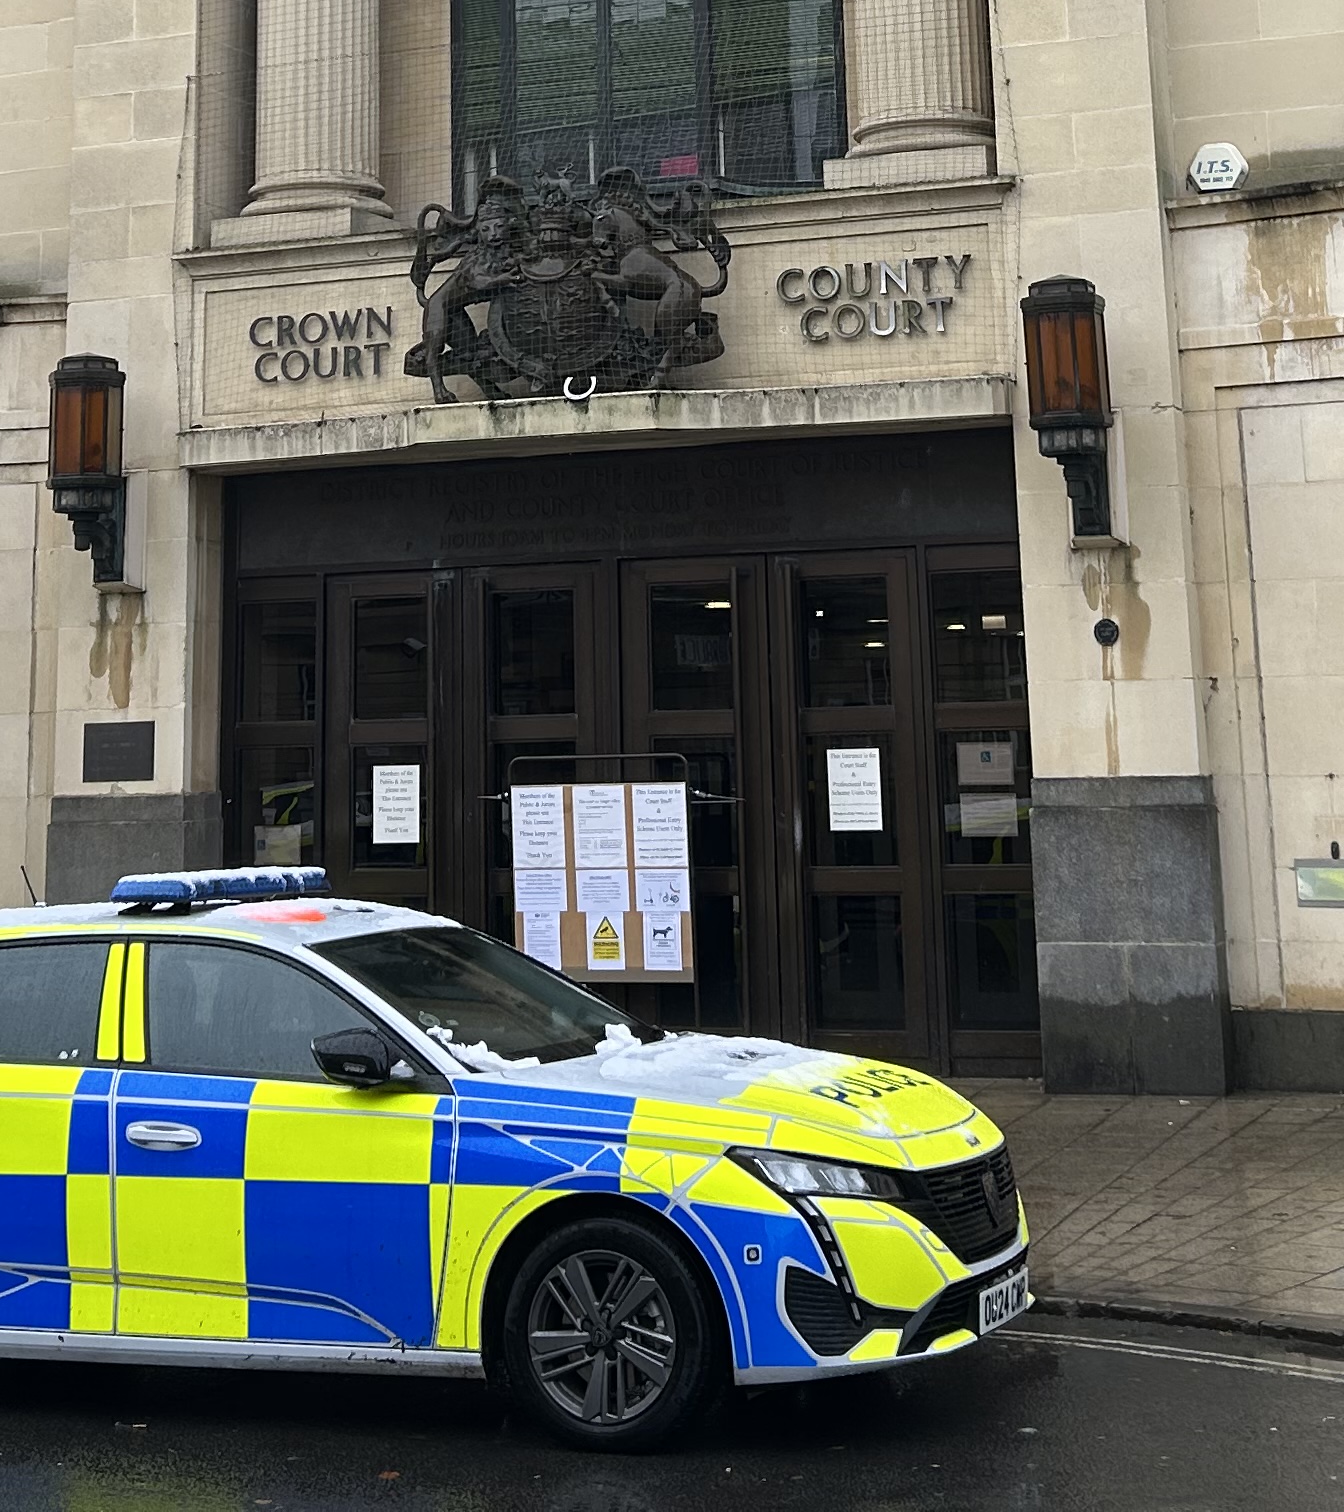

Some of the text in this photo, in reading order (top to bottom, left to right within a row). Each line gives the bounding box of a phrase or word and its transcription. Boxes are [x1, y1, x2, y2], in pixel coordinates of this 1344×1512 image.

[1196, 159, 1233, 174] I.T.S.
[776, 254, 972, 303] COUNTY
[249, 306, 393, 347] CROWN
[800, 296, 954, 342] COURT
[254, 342, 391, 383] COURT
[320, 447, 927, 502] DISTRICT REGISTRY OF THE HIGH COURT OF JUSTICE
[445, 484, 785, 524] AND COUNTY COURT OFFICE
[440, 531, 495, 550] HOURS
[985, 1286, 1009, 1326] OU24
